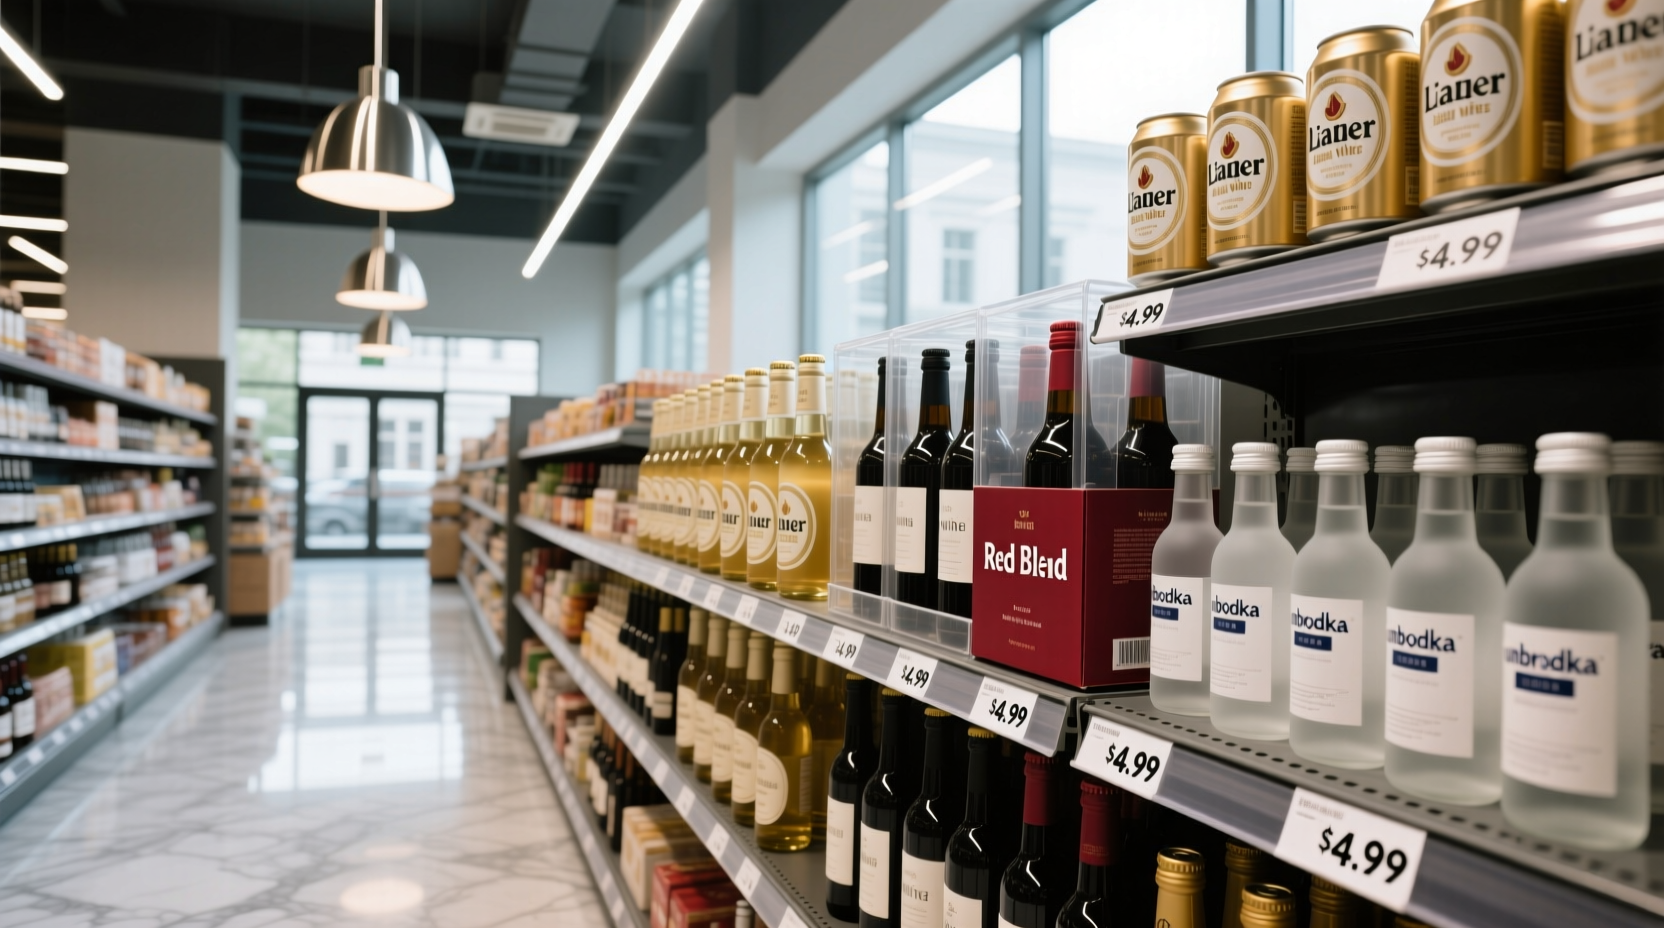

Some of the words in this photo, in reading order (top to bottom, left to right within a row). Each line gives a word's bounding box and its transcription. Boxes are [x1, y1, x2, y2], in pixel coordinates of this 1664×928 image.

[1575, 13, 1664, 62] Liane
[1416, 231, 1504, 271] $4.99
[1119, 302, 1164, 329] $4.99
[984, 541, 1015, 574] Red
[988, 698, 1028, 728] $4.99
[1105, 742, 1161, 783] $4.99
[1318, 824, 1408, 884] $4.99
